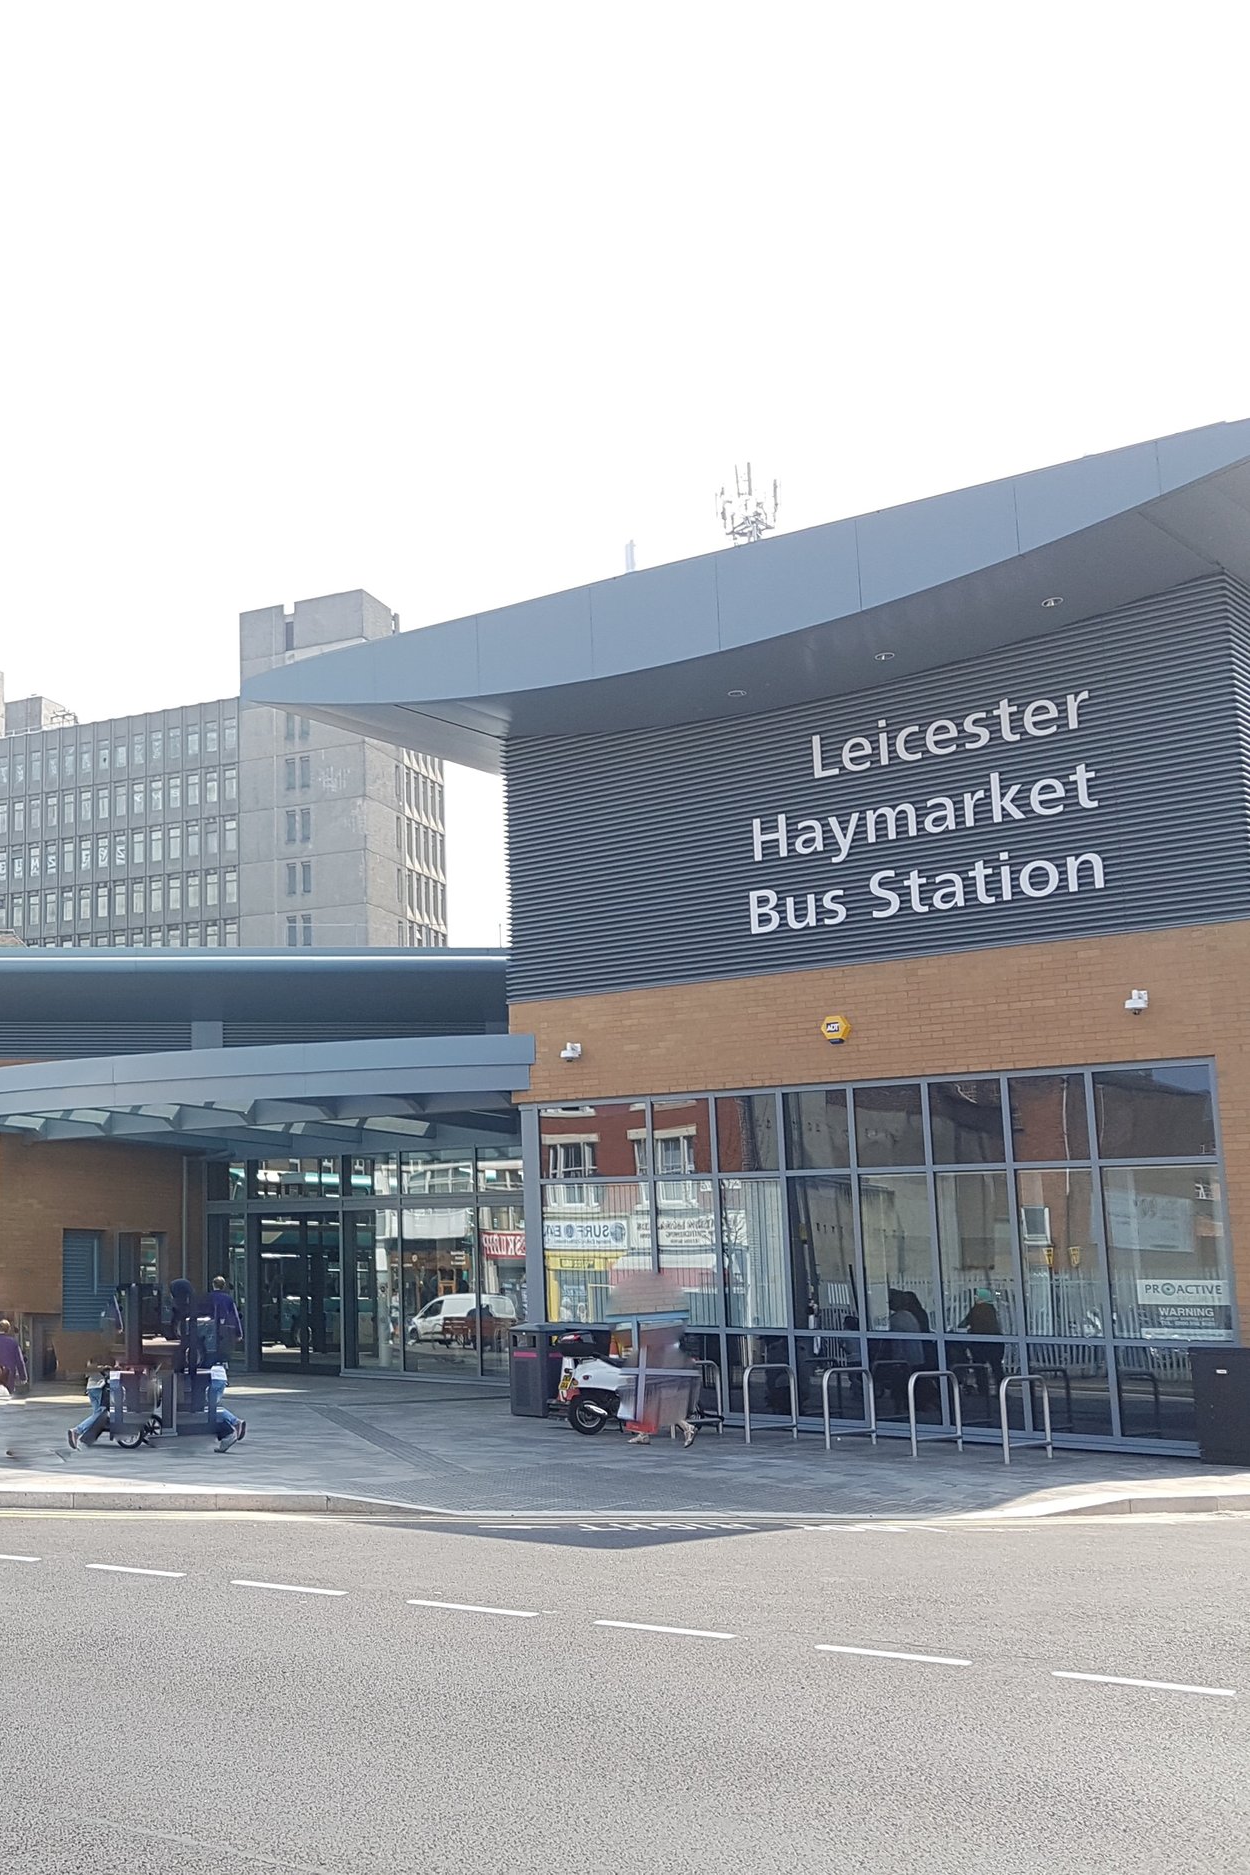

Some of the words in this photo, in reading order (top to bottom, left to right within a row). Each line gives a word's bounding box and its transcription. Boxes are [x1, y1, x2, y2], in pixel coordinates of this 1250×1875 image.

[811, 689, 1090, 779] Leicester
[751, 762, 1099, 863] Haymarket
[749, 888, 847, 935] Bus
[869, 851, 1105, 919] Station
[826, 1022, 839, 1032] ADT
[1144, 1283, 1223, 1296] PROACTIVE
[1158, 1307, 1215, 1317] WARNING
